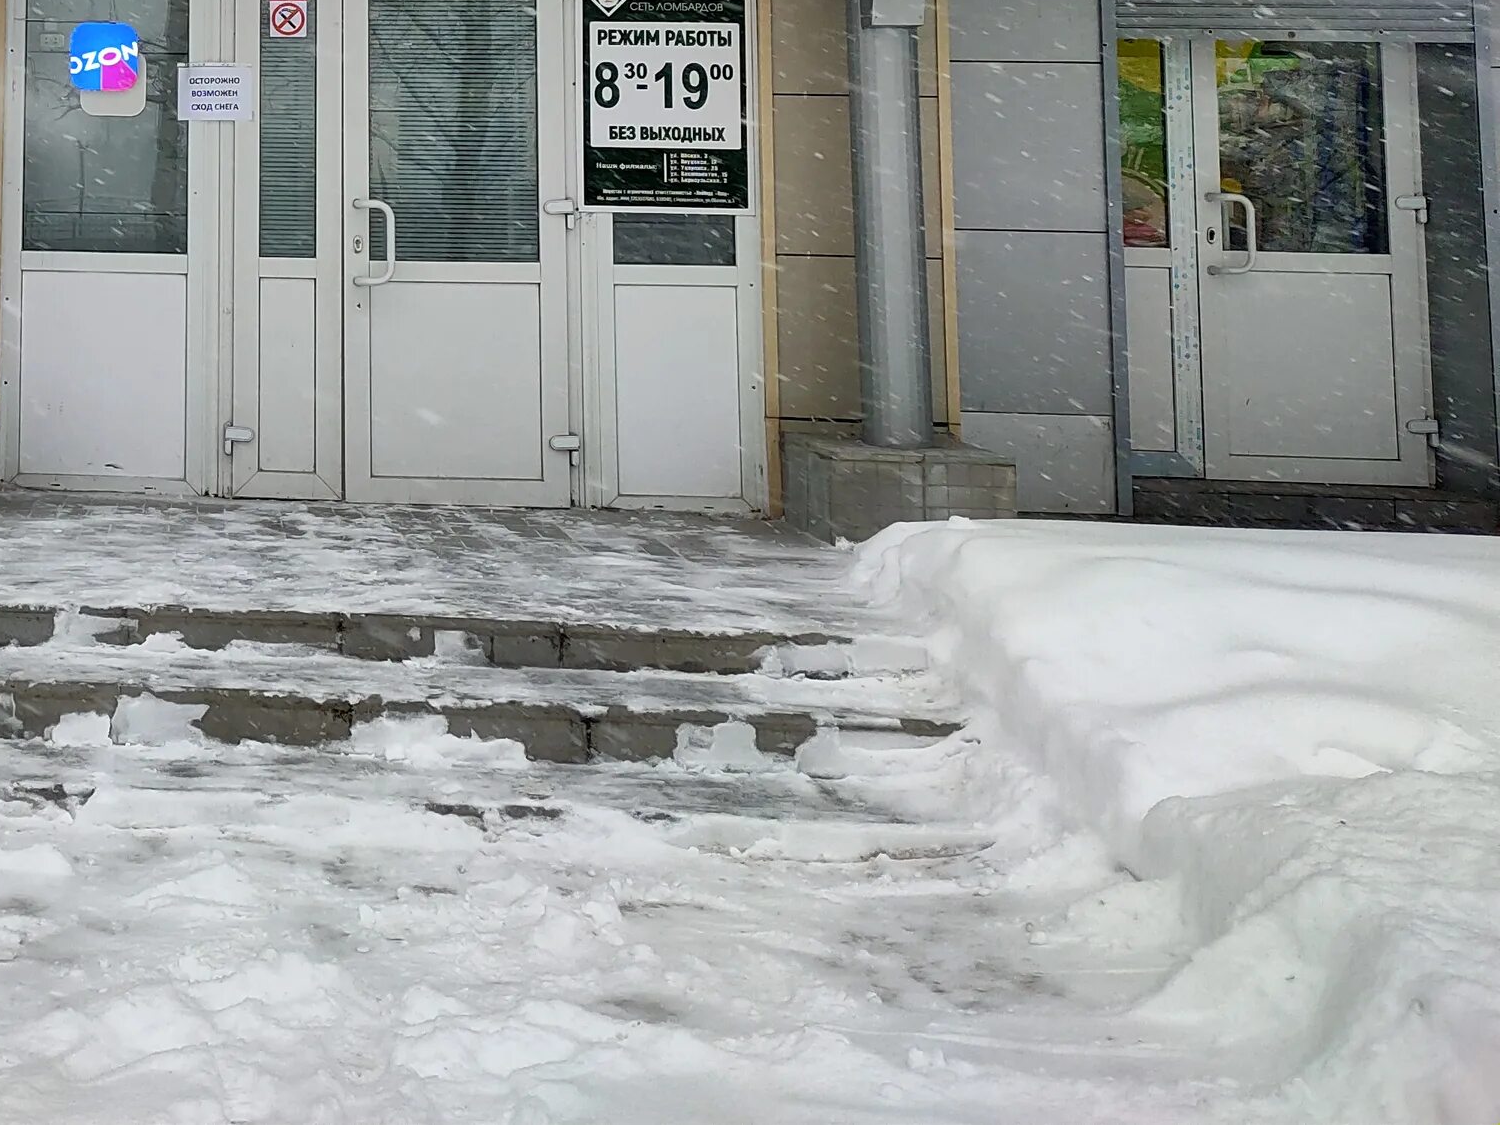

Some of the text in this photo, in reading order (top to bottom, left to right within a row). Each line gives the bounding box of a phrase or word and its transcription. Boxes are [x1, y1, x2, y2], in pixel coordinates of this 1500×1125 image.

[629, 2, 723, 12] СЕТЬ ЛОМБАРДОВ
[597, 29, 732, 47] РЕЖИМ РАБОТЫ
[70, 41, 138, 74] OZON
[189, 77, 240, 85] ОСТОРОЖНО
[191, 103, 239, 111] СХОД СНЕГА
[609, 125, 726, 143] БЕЗ ВЫХОДНЫХ
